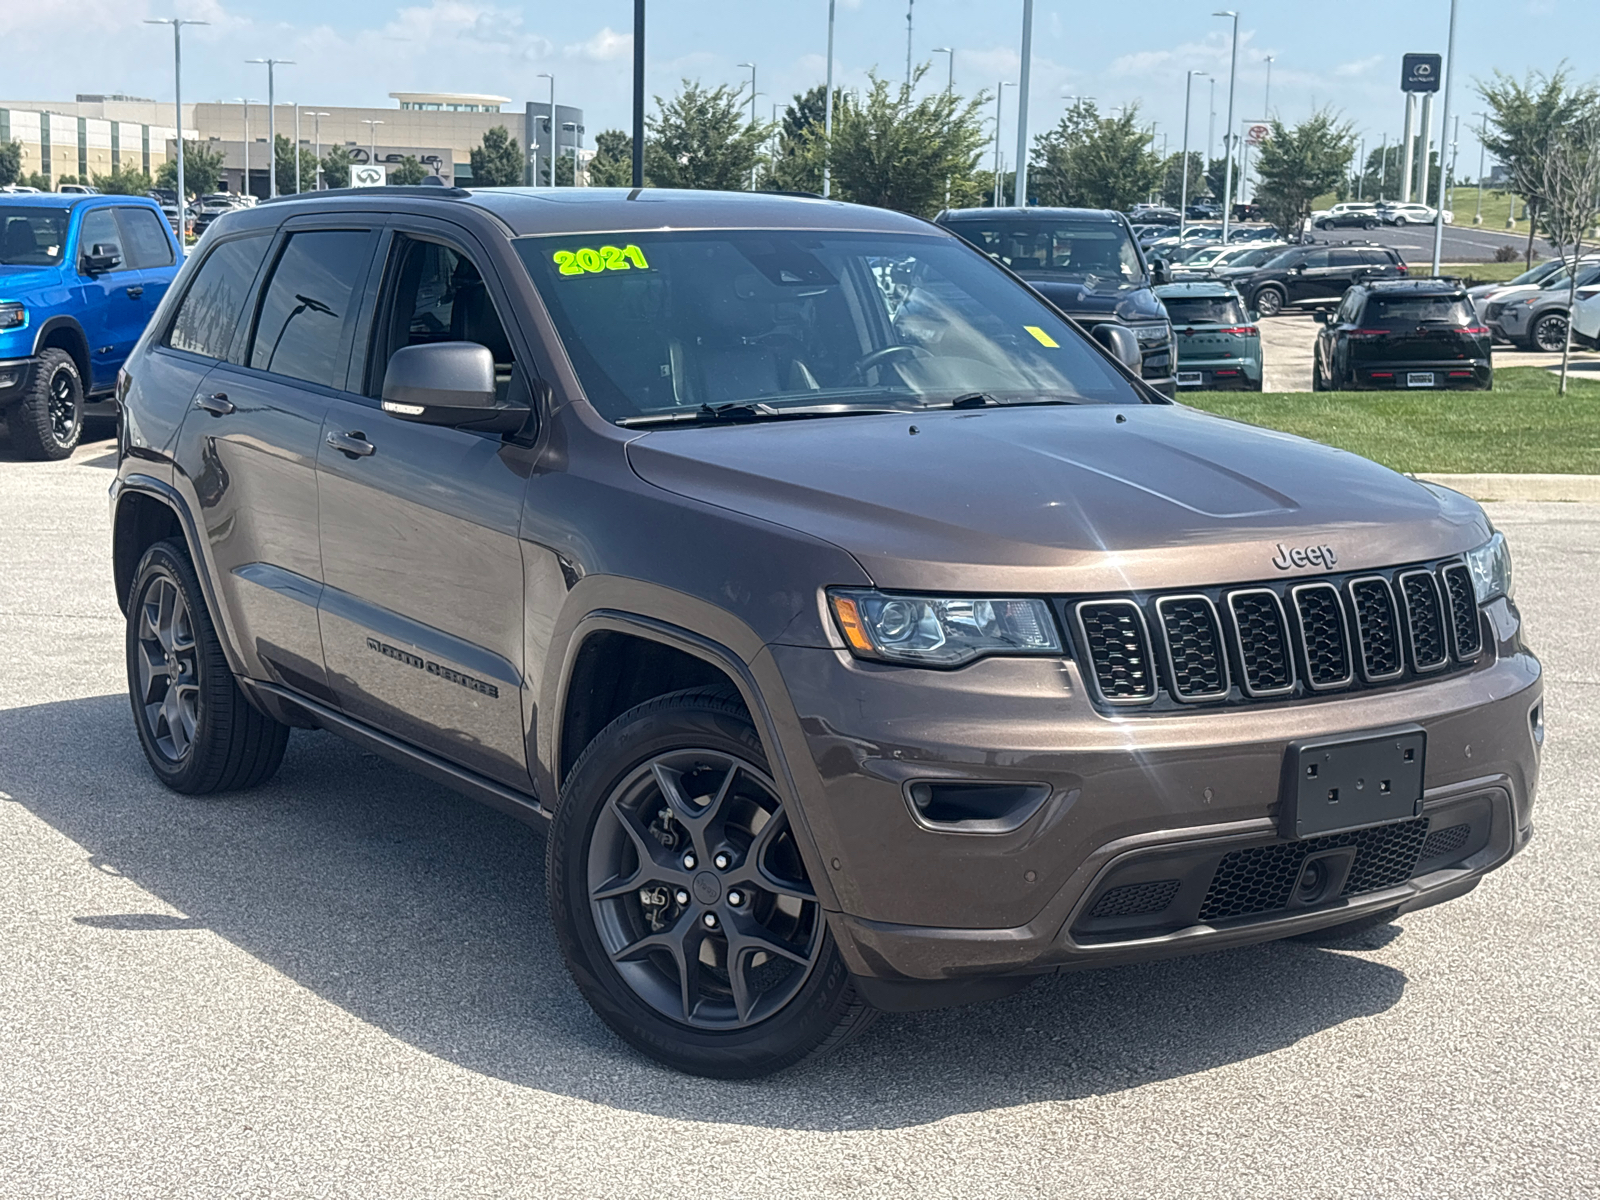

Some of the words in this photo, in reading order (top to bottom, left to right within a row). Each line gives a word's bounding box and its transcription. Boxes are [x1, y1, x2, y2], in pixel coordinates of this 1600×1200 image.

[374, 153, 442, 165] LEUS
[553, 244, 649, 276] 2021
[1271, 543, 1338, 571] Jeep
[366, 637, 424, 670] GRAND
[425, 660, 499, 699] CHEROKEE
